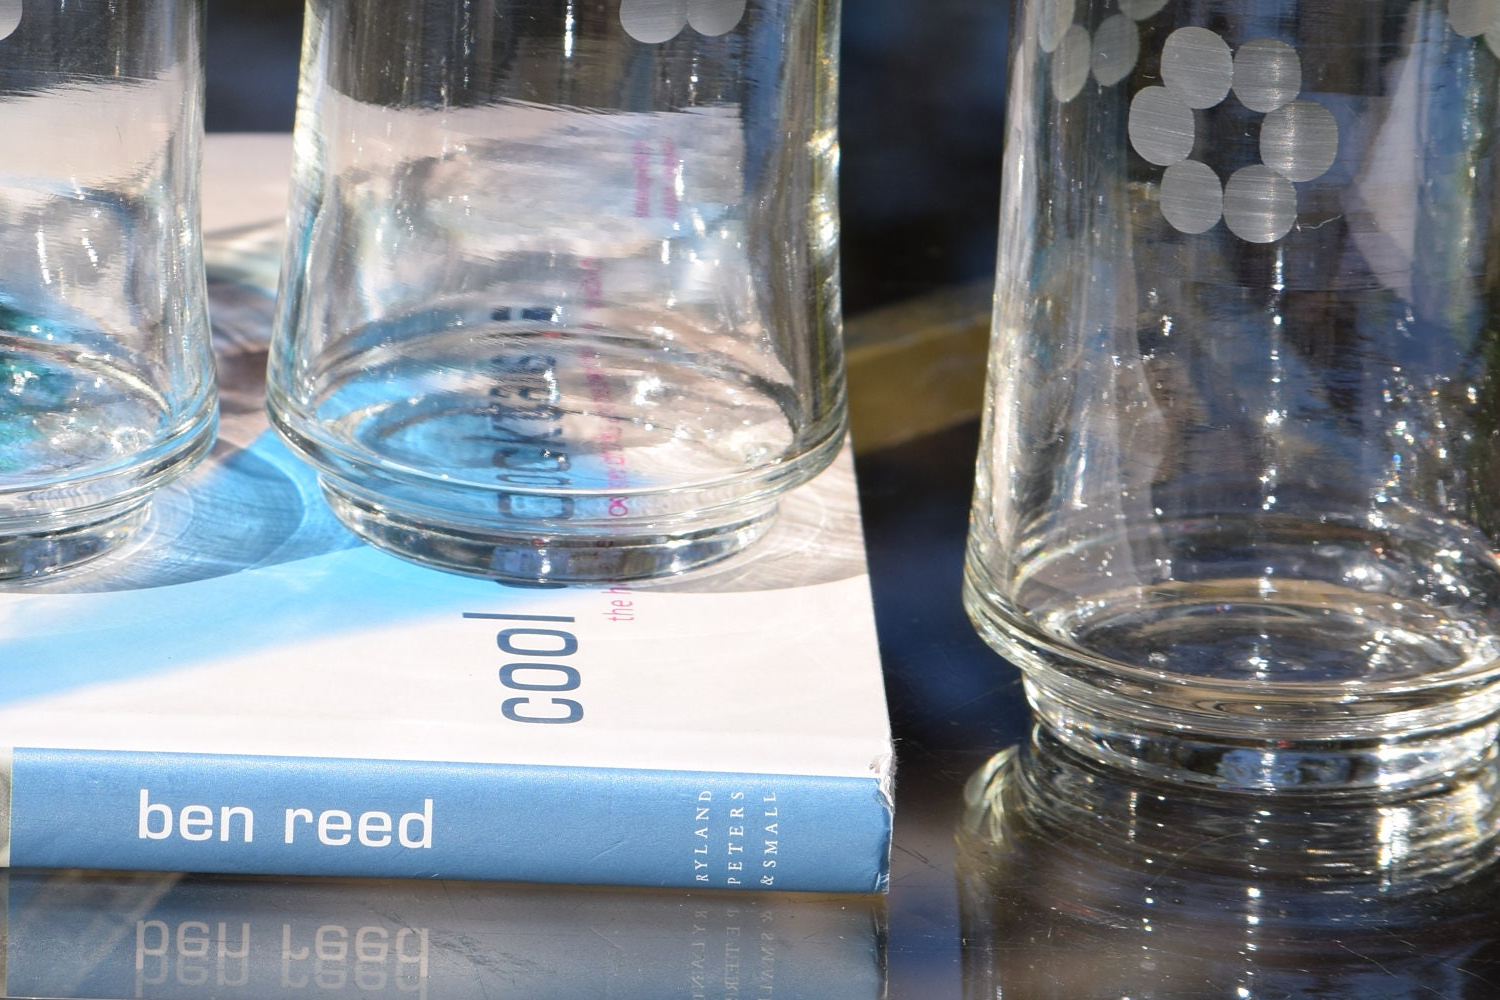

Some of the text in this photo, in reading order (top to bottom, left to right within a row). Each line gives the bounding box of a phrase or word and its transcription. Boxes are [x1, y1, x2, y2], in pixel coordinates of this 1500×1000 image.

[602, 599, 635, 623] the
[461, 611, 585, 726] cool
[137, 788, 434, 850] ben reed
[693, 789, 713, 883] RYLAND
[726, 790, 745, 885] PETERS
[759, 791, 779, 886] & SMALL
